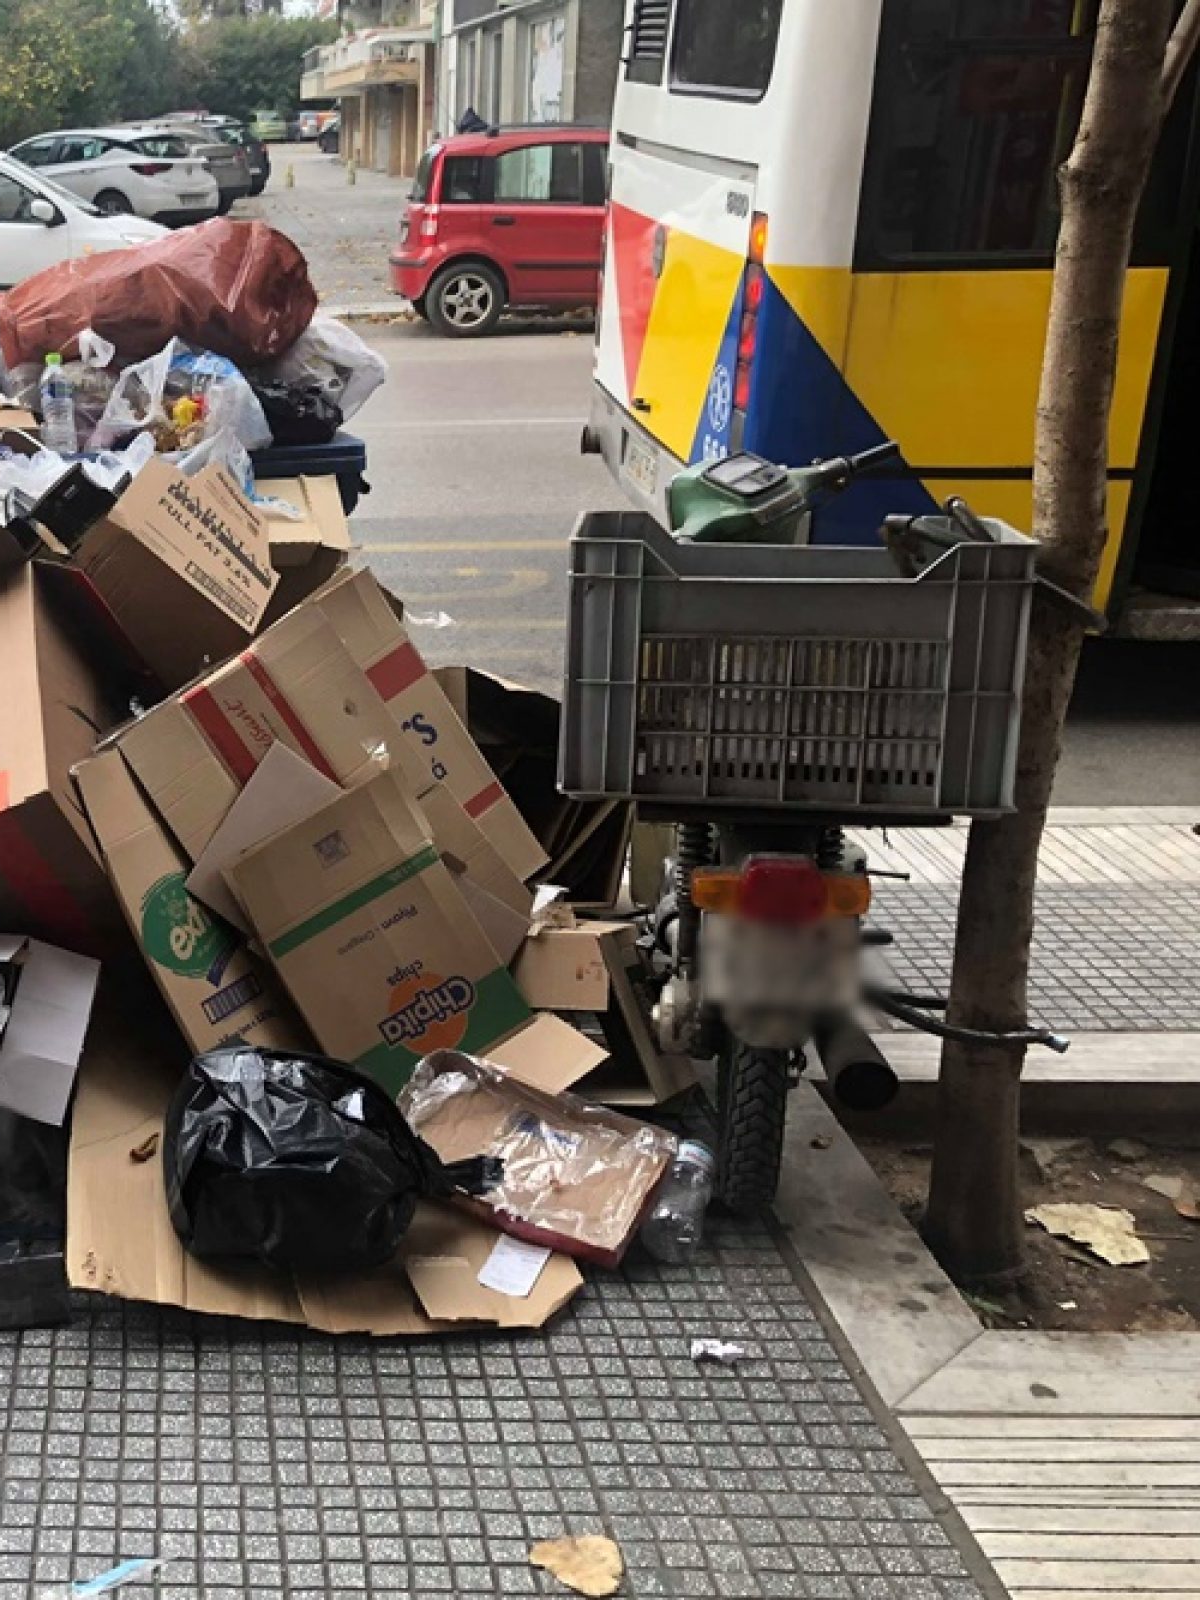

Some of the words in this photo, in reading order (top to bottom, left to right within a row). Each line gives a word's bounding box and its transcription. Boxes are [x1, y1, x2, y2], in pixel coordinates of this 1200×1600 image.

[158, 497, 192, 533] FULL
[196, 532, 221, 557] FAT
[377, 976, 476, 1046] Chipita
